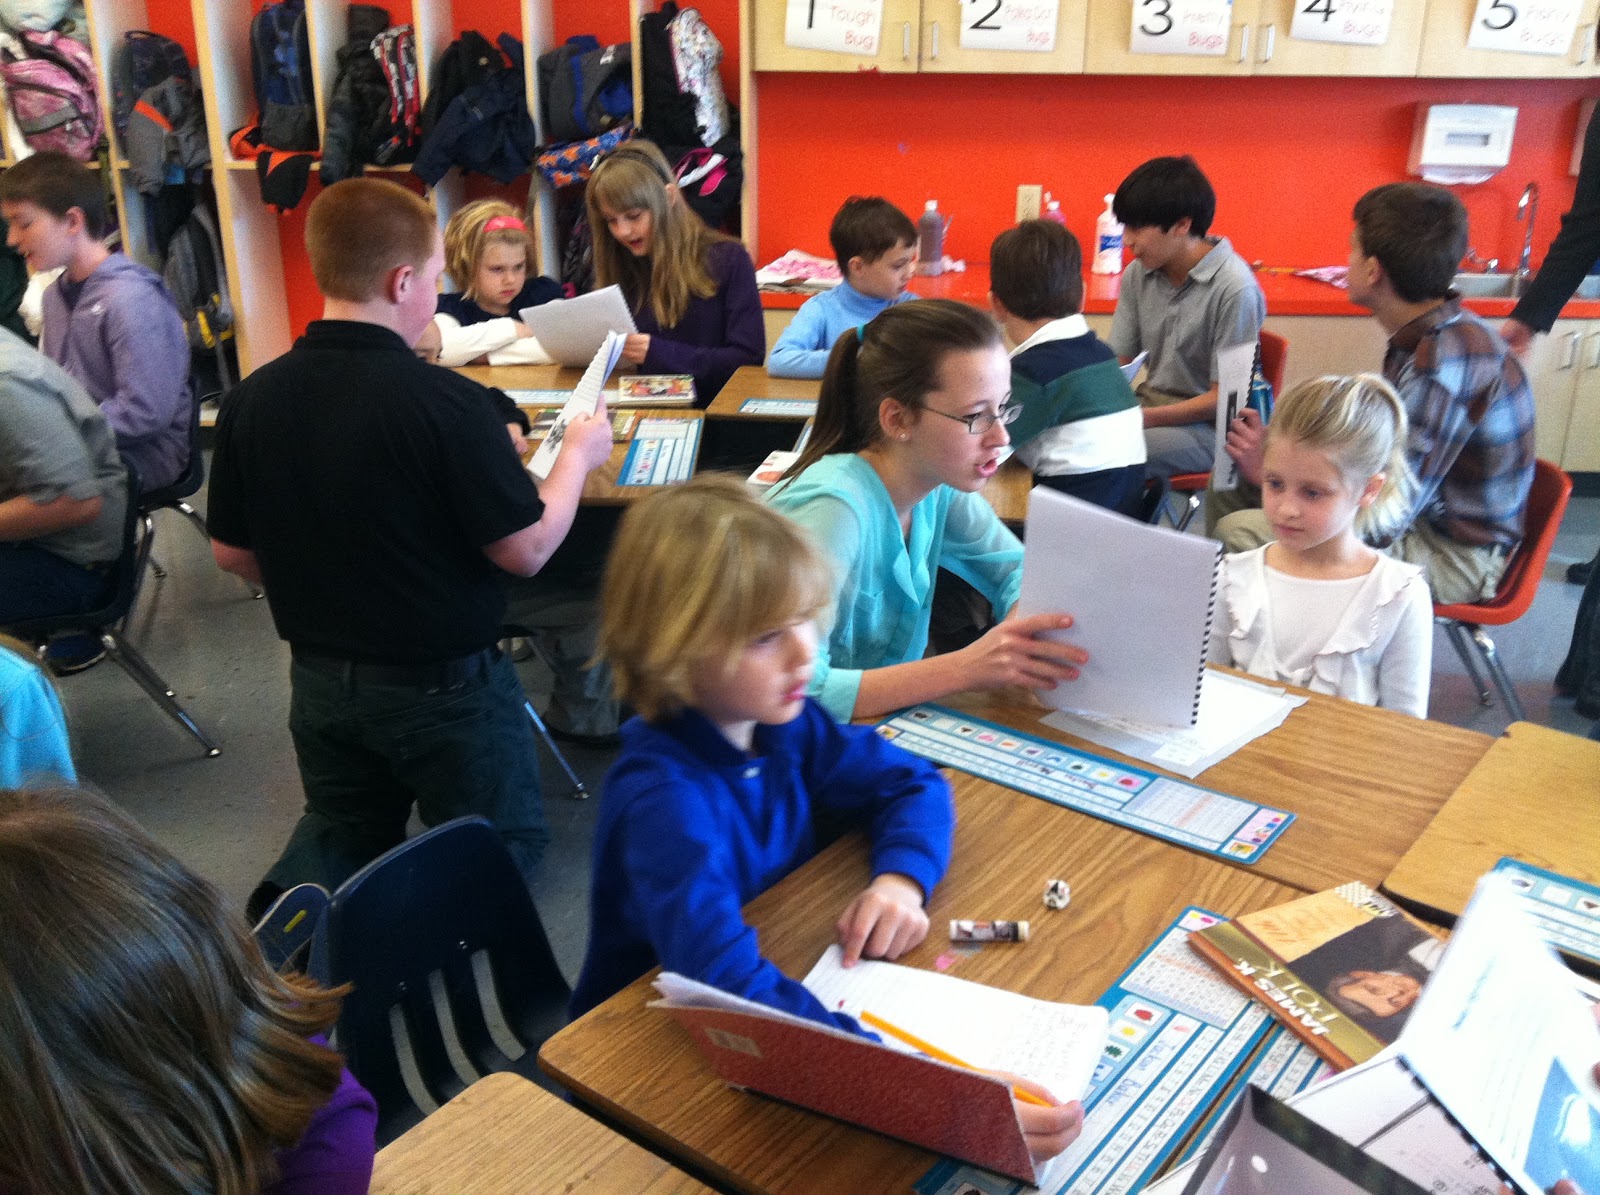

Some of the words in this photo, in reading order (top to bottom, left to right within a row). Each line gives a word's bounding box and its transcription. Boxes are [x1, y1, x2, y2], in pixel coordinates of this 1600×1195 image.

[969, 0, 1003, 30] 2
[1139, 0, 1174, 36] 3
[1301, 0, 1338, 24] 4
[1482, 0, 1519, 31] 5
[1232, 957, 1258, 977] K.
[1253, 977, 1331, 1036] JAMES
[1254, 960, 1340, 1023] POLK
